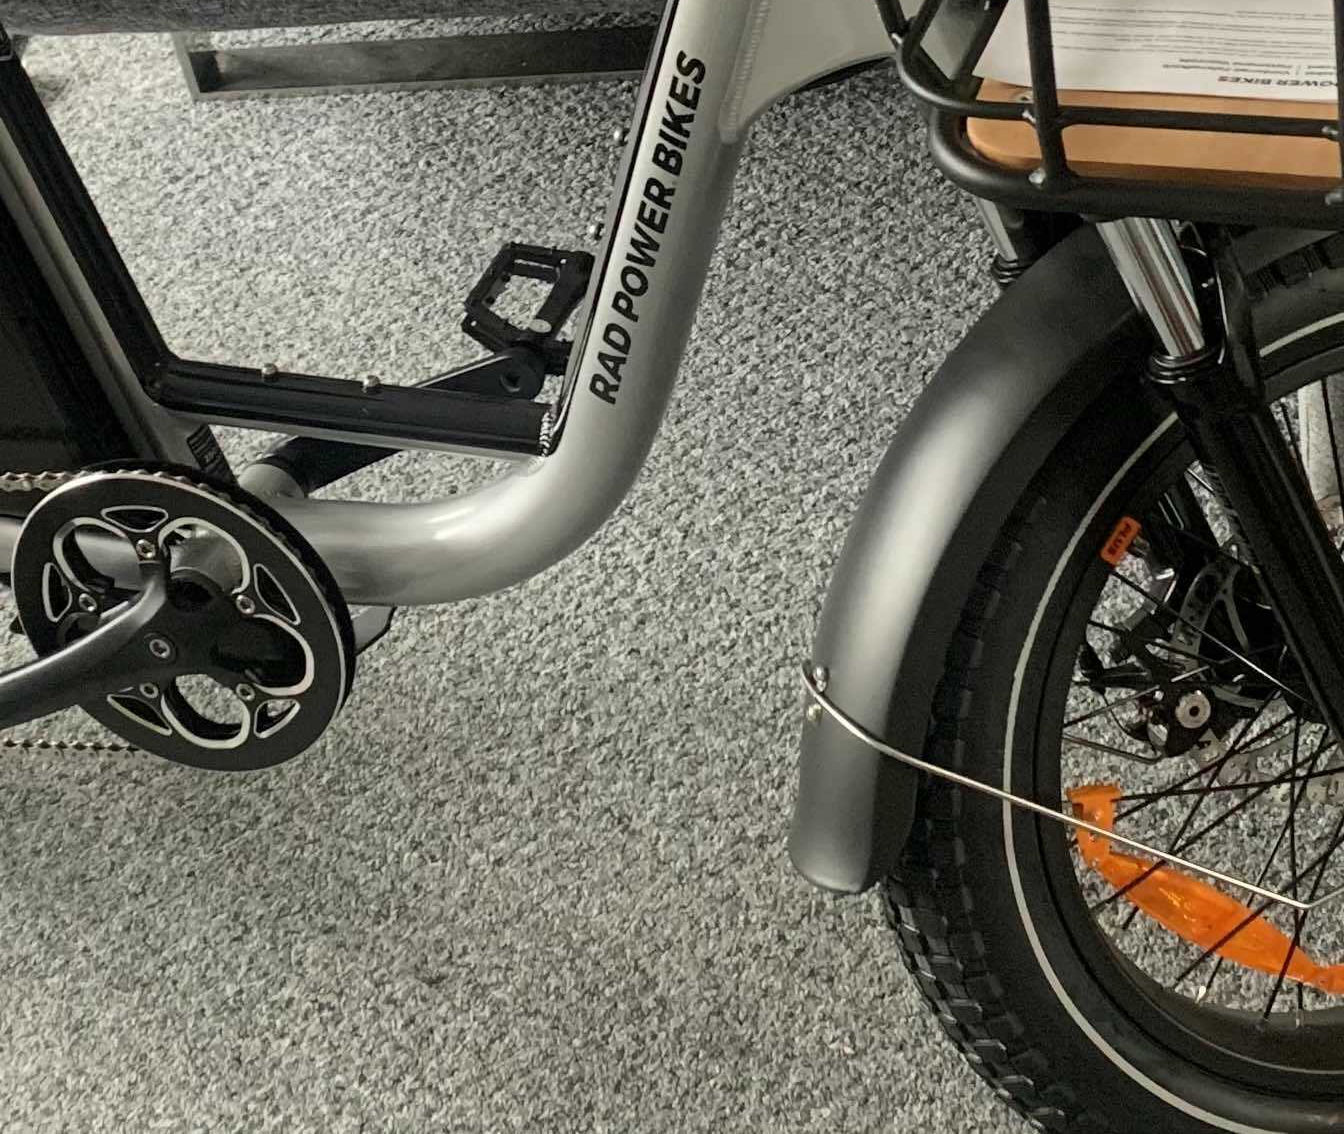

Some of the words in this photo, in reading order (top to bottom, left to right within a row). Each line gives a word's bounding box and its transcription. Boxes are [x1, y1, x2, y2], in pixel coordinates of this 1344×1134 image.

[1276, 79, 1338, 87] OWER
[589, 321, 632, 405] RAD
[611, 177, 676, 323] POWER
[652, 50, 707, 177] BIKES
